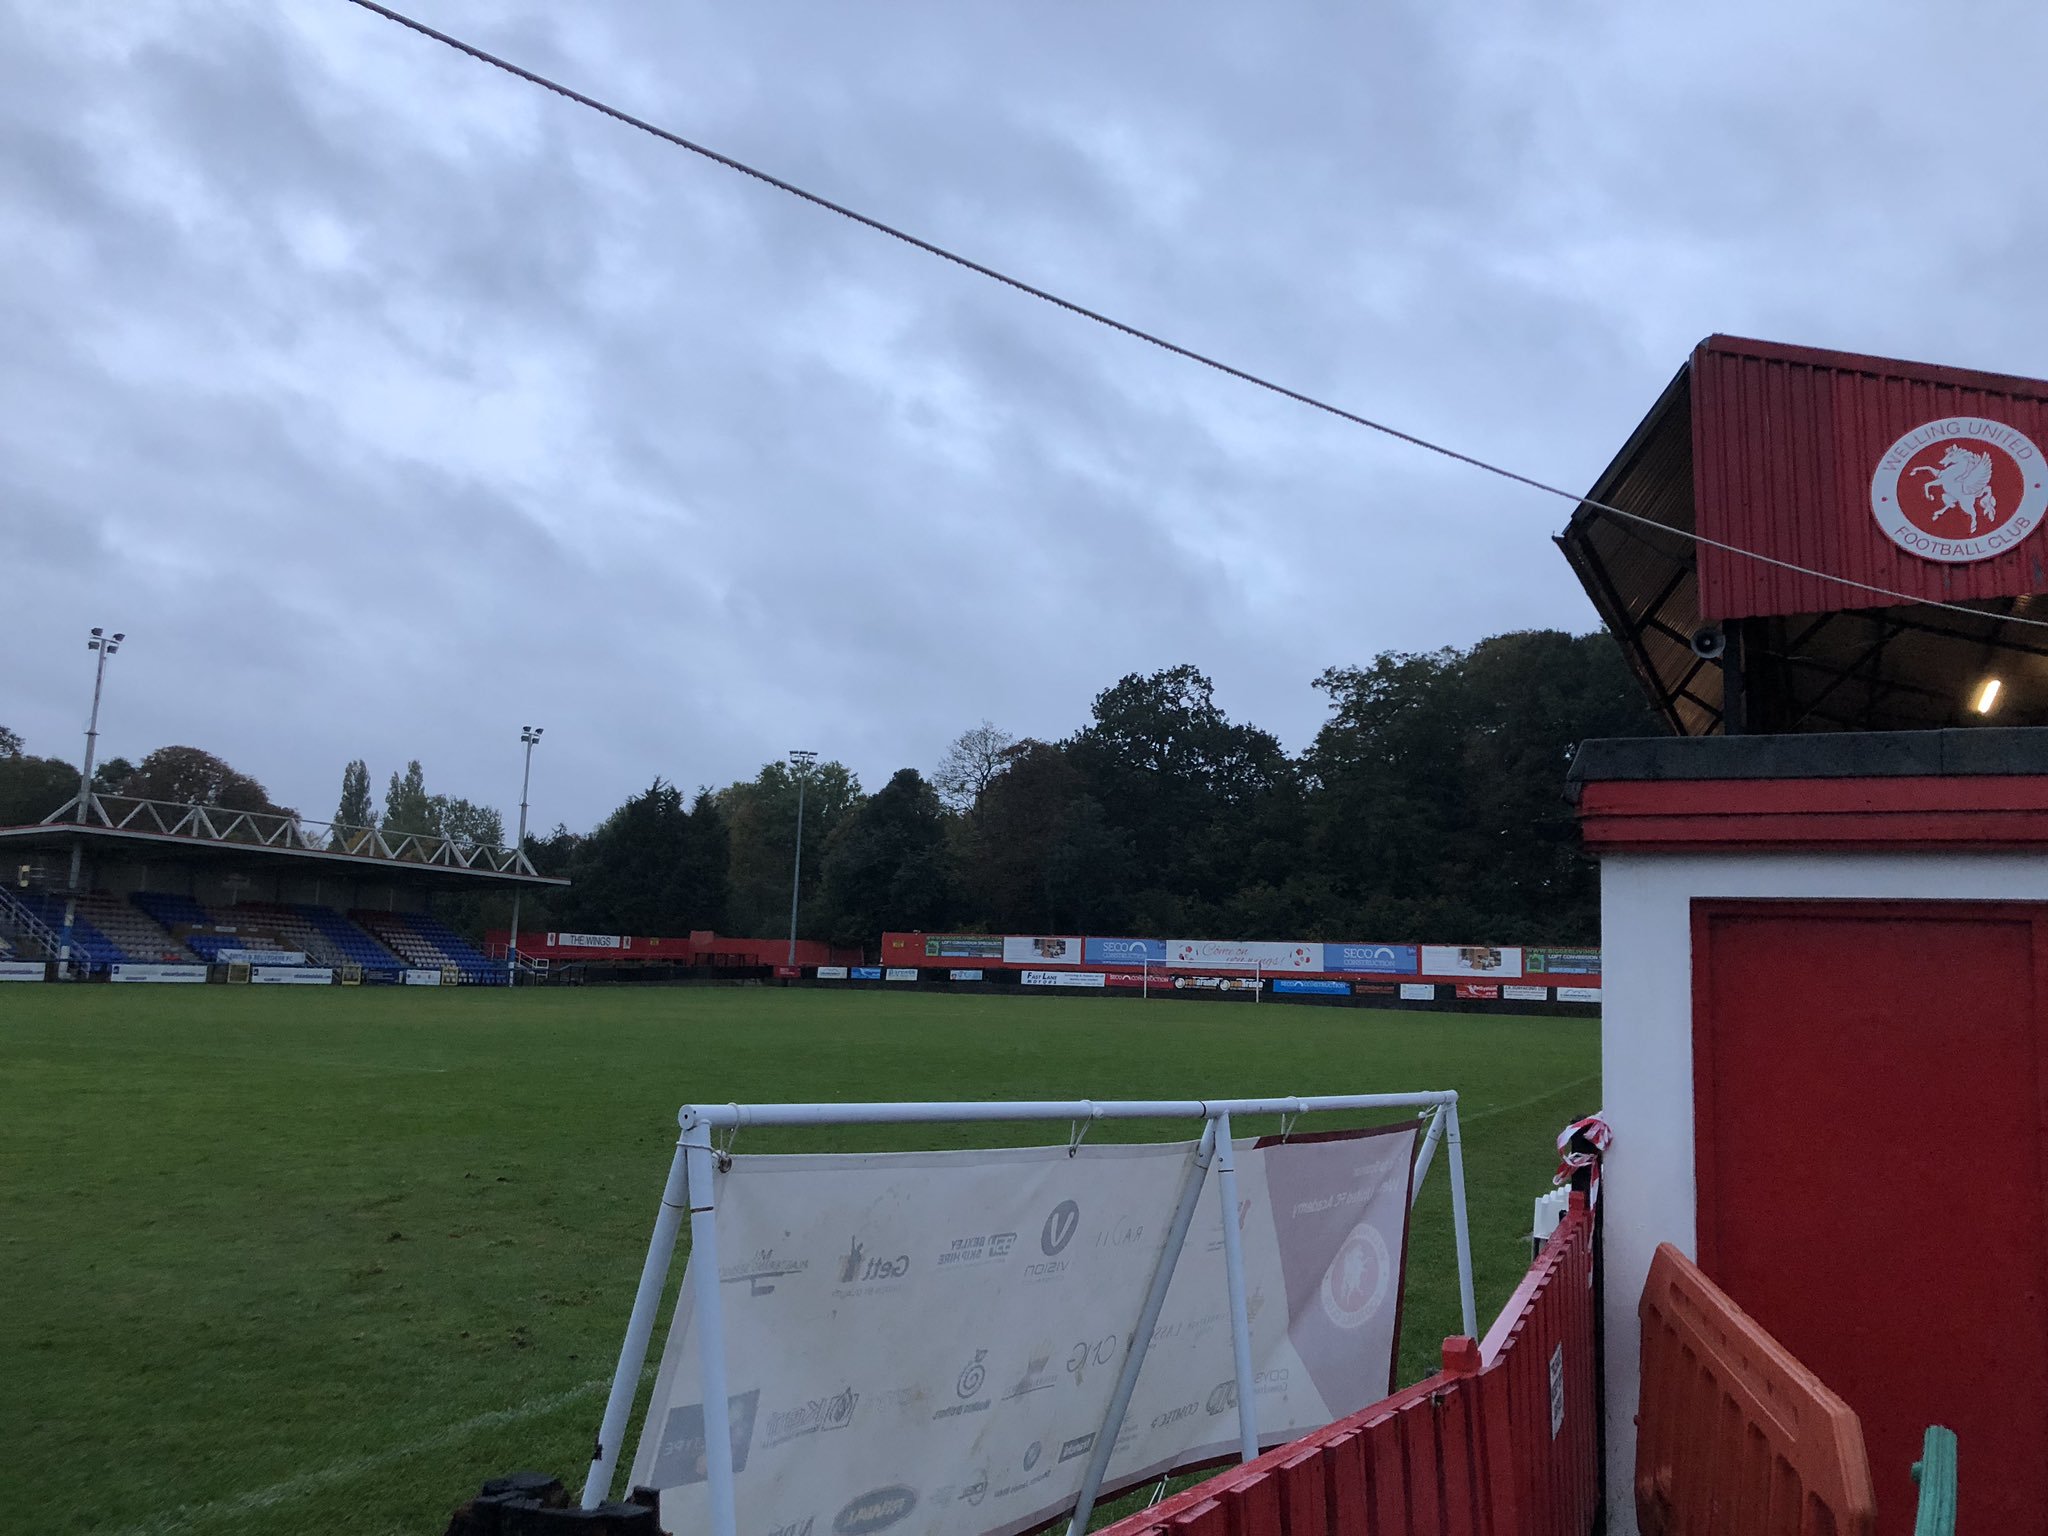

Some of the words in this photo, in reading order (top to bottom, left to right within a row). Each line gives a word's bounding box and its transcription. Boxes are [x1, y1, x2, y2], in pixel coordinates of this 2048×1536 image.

[1882, 421, 1961, 472] WELLING
[1968, 422, 2033, 461] UNITED
[1894, 526, 1986, 557] FOOTBALL
[1987, 517, 2031, 550] CLUB
[570, 935, 584, 945] THE
[586, 936, 611, 946] WINGS
[1103, 942, 1128, 952] SECO
[1343, 948, 1374, 959] SECO
[1343, 959, 1395, 967] CONSTRUCTION
